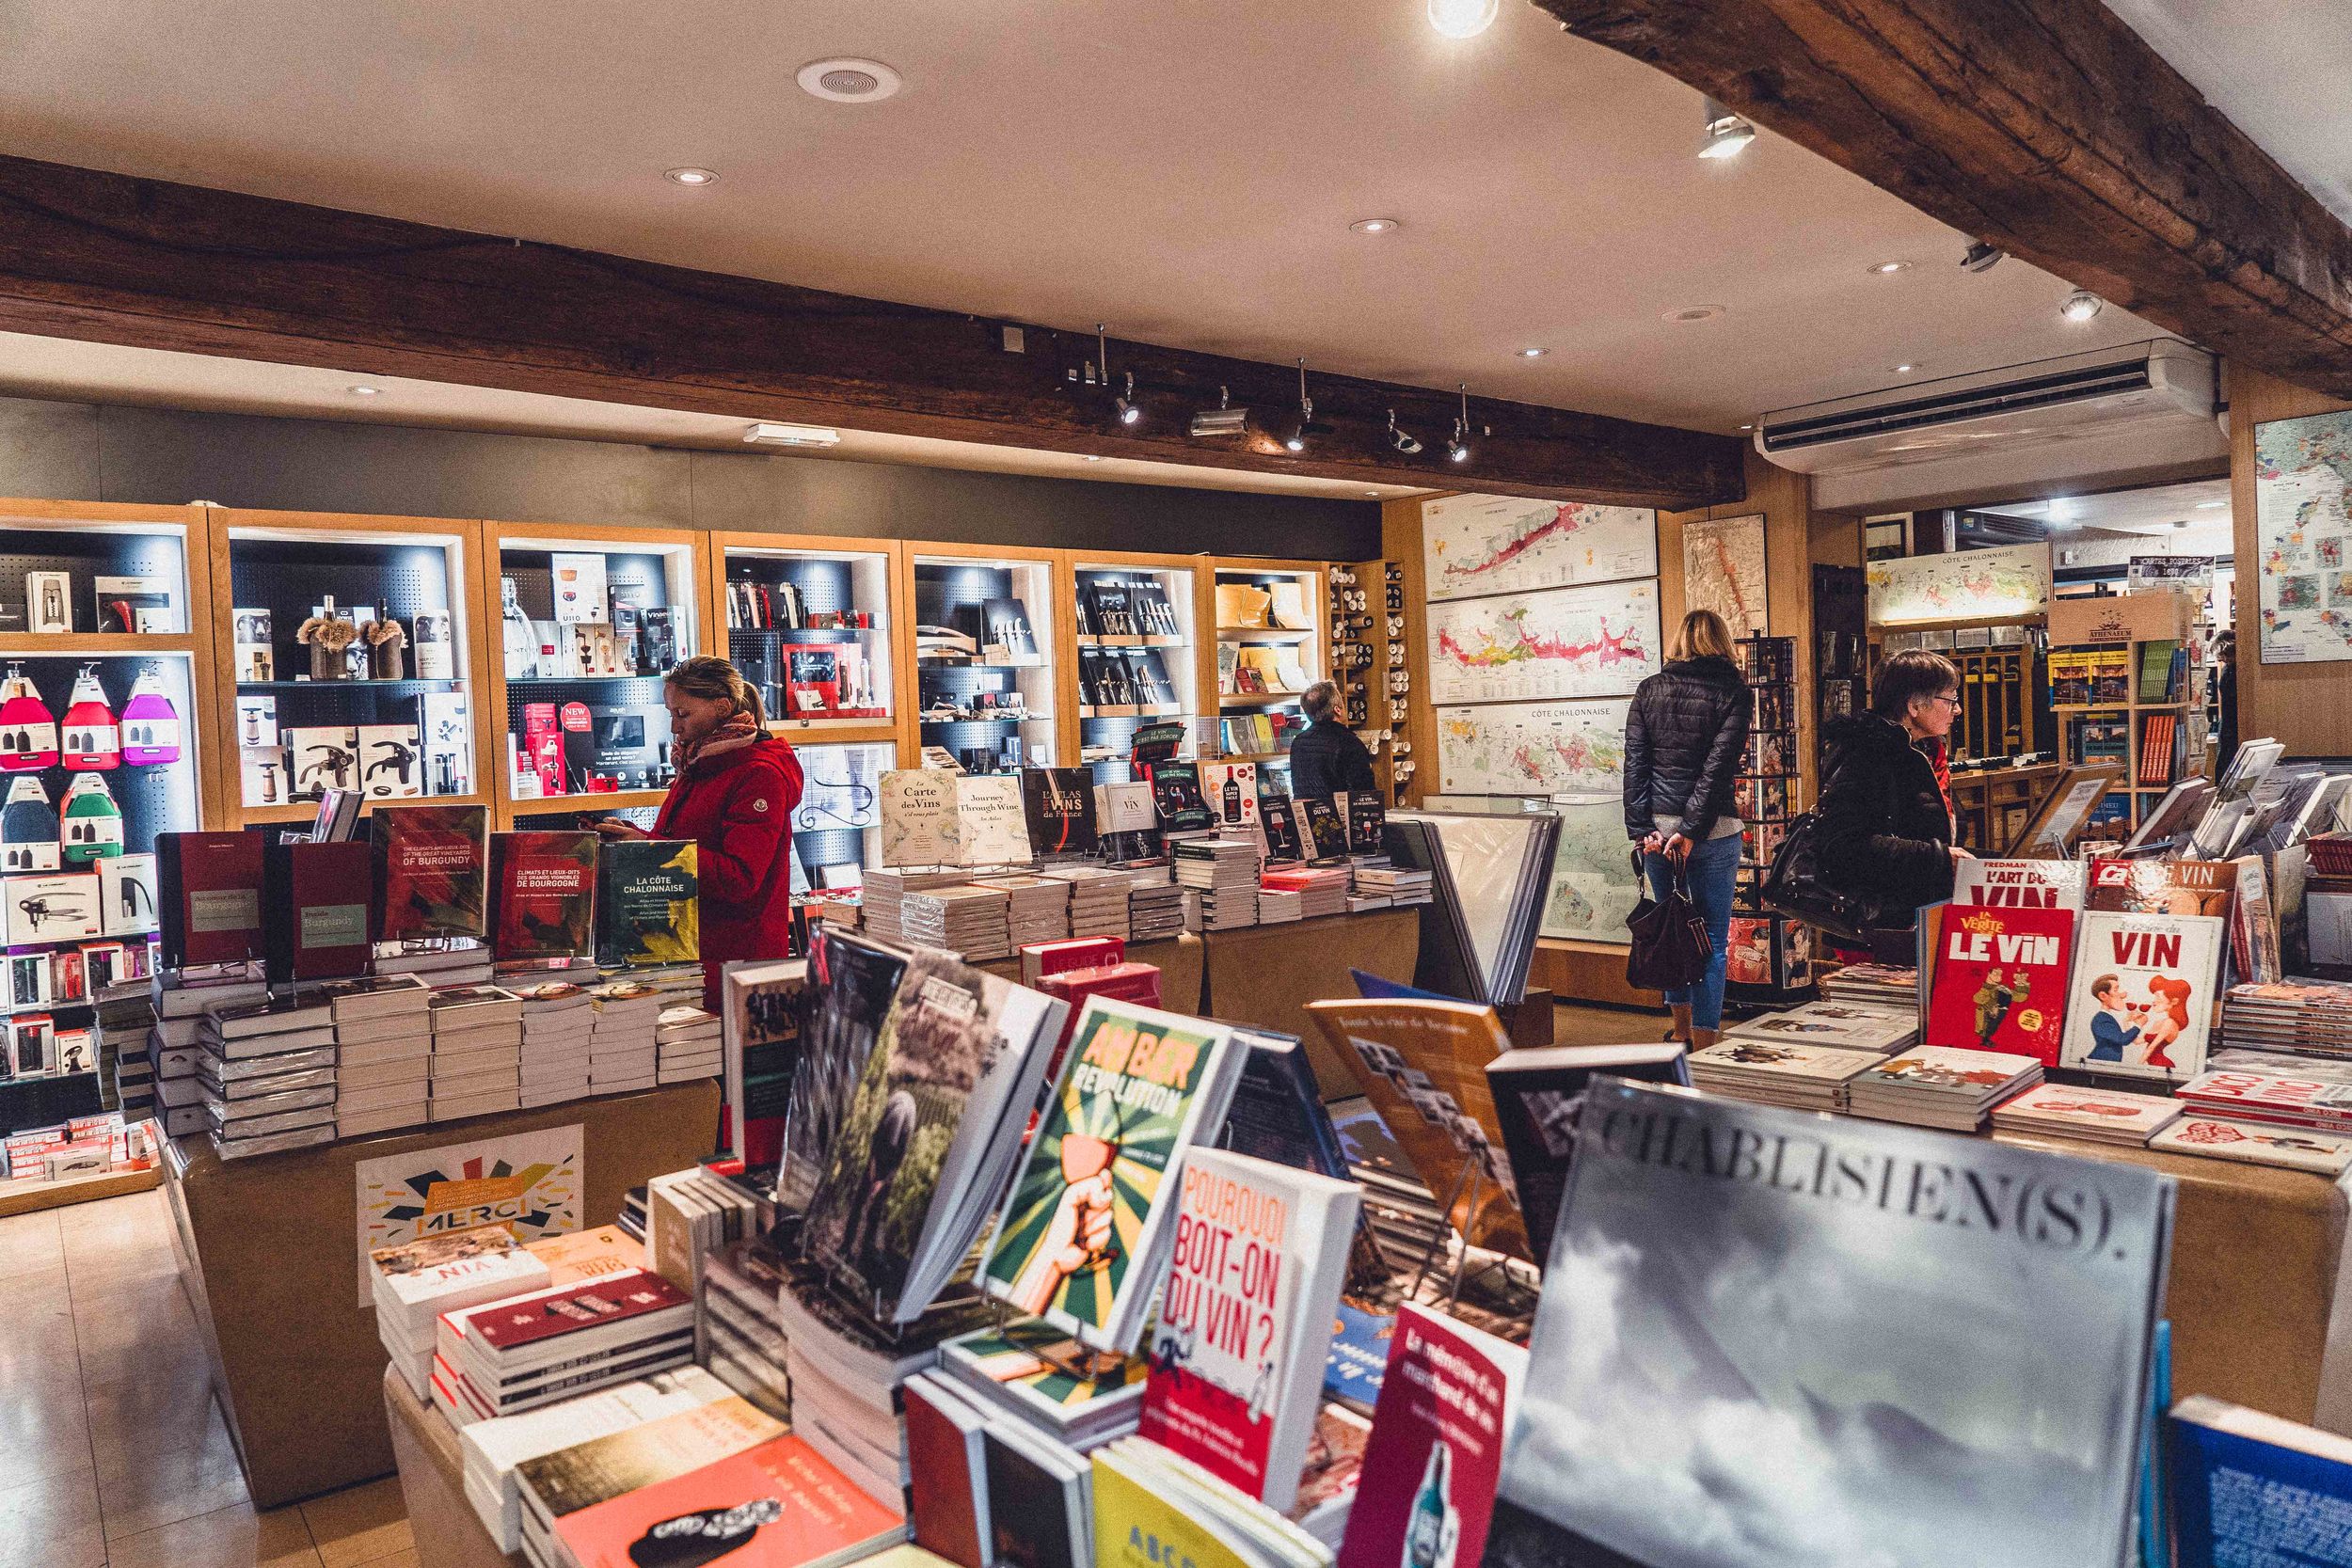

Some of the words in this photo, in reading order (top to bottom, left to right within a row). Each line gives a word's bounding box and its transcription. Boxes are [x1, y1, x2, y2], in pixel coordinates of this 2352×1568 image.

[1963, 551, 2014, 562] CHALONNAISE
[1554, 707, 1611, 717] CHALONNAISE
[904, 787, 936, 797] Carte
[915, 800, 941, 808] Vins
[971, 795, 1004, 803] Journey
[960, 803, 995, 813] Through
[1051, 800, 1082, 810] VINS
[419, 856, 470, 865] BURGUNDY
[650, 876, 672, 884] CÔTE
[1987, 871, 2023, 883] L'ART
[2183, 865, 2214, 884] VIN
[624, 885, 684, 894] CHALONNAISE
[1970, 885, 2058, 908] VIN
[1979, 911, 1992, 919] LA
[2165, 924, 2181, 933] du
[1949, 931, 1993, 961] LE
[2112, 931, 2182, 969] VIN
[1081, 1022, 1200, 1090] AMBER
[2198, 1074, 2264, 1097] DICO
[2260, 1081, 2324, 1102] VINO
[418, 1198, 526, 1235] MERCI
[1174, 1213, 1281, 1309] BOIT-ON
[1165, 1272, 1202, 1336] DU
[1206, 1289, 1252, 1360] VIN
